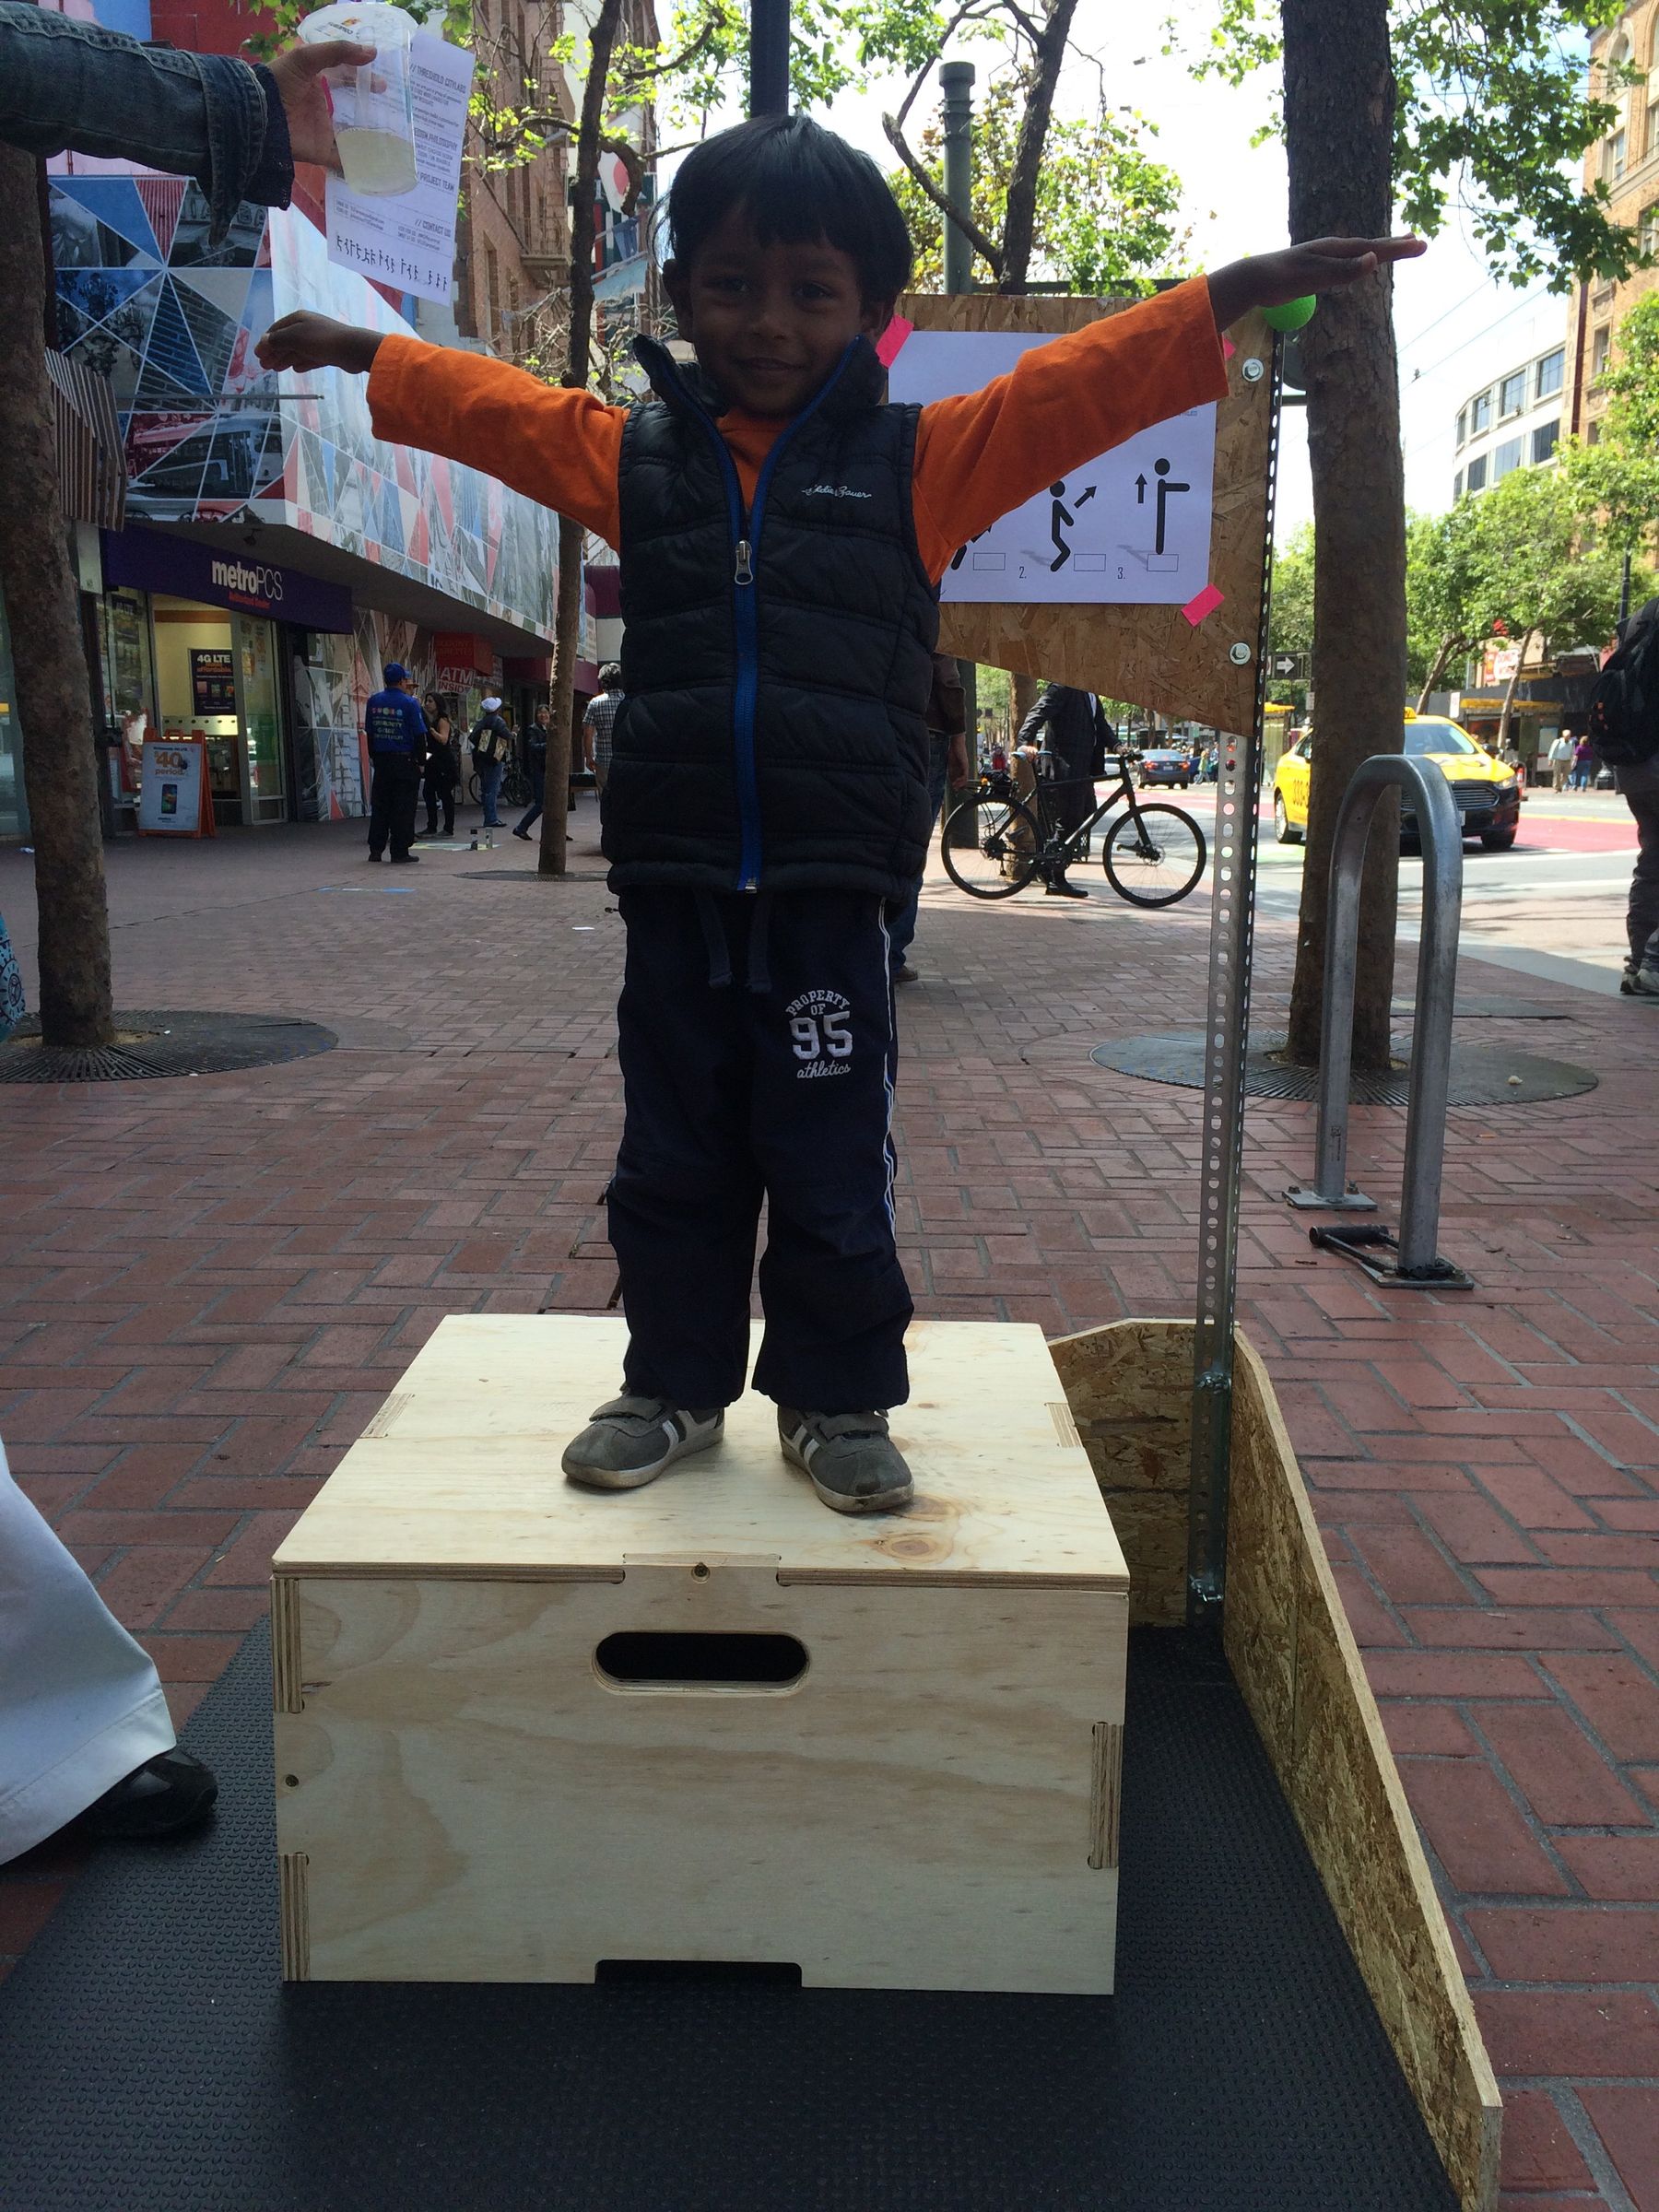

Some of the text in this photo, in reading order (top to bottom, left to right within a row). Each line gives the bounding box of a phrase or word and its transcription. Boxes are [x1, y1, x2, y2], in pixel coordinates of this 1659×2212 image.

[834, 486, 872, 498] Bauer
[211, 559, 283, 601] metroPCS
[1018, 566, 1028, 580] 2.
[1117, 566, 1126, 580] 3.
[196, 654, 231, 664] 4G LTE
[440, 667, 474, 686] ATM
[785, 990, 851, 1017] PROPERTY
[810, 1003, 826, 1016] OF
[789, 1010, 853, 1060] 95
[796, 1060, 852, 1078] athletics
